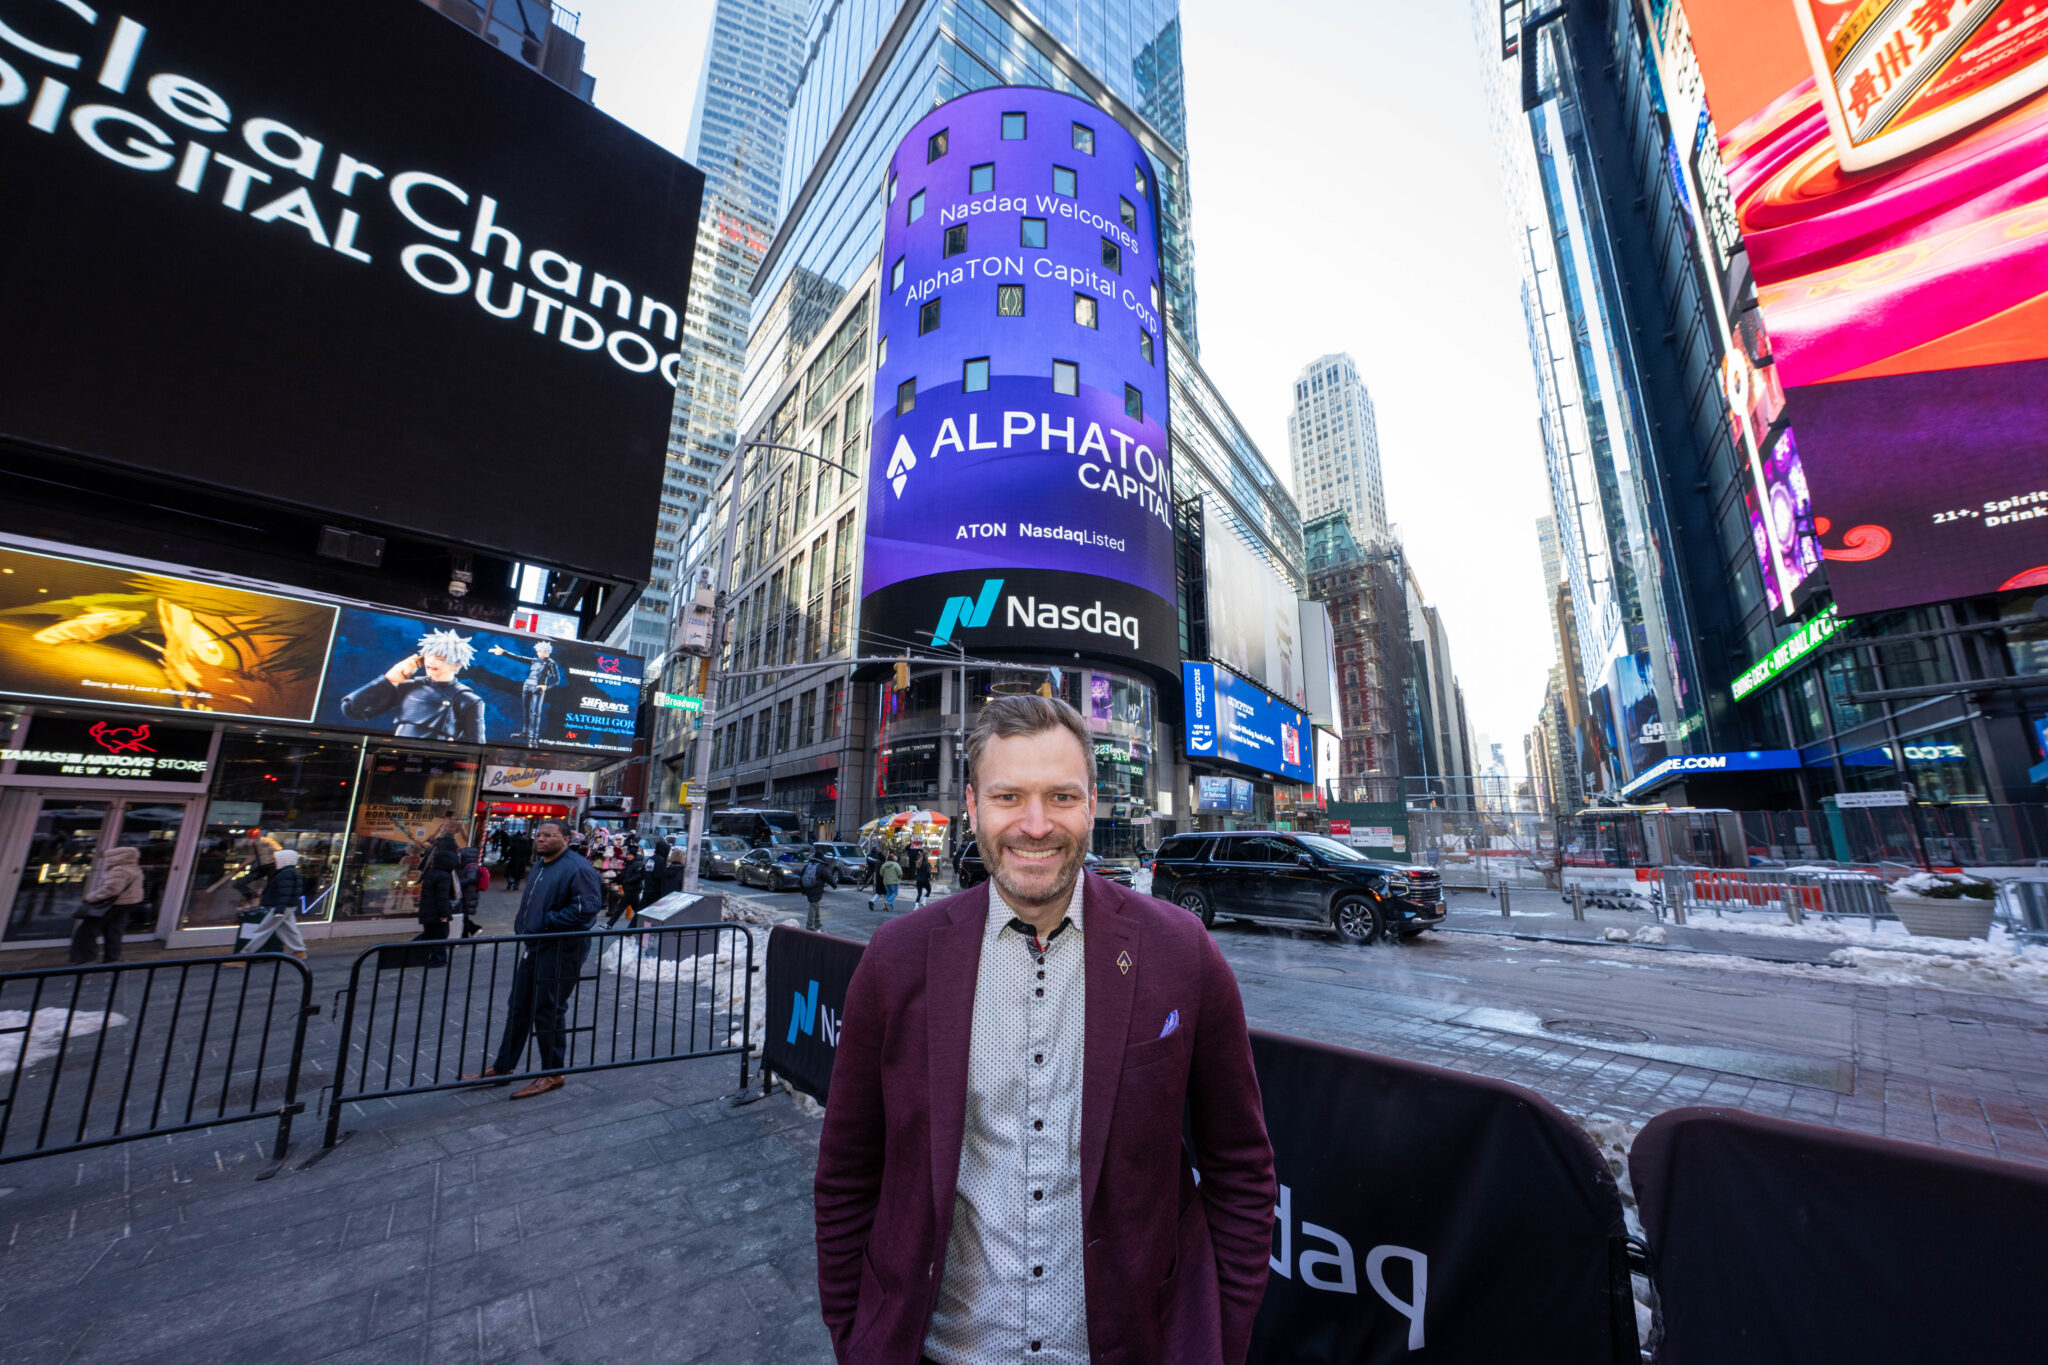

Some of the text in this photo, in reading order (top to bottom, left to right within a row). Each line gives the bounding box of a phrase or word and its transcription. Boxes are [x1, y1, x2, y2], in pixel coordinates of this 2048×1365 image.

[940, 194, 1139, 254] Nasdaq Welcomes
[905, 256, 1160, 338] AlphaTON Capital Corp.
[930, 411, 1171, 502] ALPHATON
[1078, 462, 1172, 531] CAPITAL
[1932, 508, 1980, 524] 21+,
[1984, 506, 2048, 528] Drink
[956, 522, 1007, 540] ATON
[1007, 595, 1139, 649] Nasdaq
[665, 695, 700, 711] Broadway
[1194, 668, 1202, 719] GUMPTION
[565, 712, 610, 725] SATORU
[1, 749, 208, 772] TAMASHII NATIONS STORE
[61, 765, 151, 777] NEW YORK
[489, 767, 552, 787] Brooklyn
[392, 796, 452, 806] Welcome to
